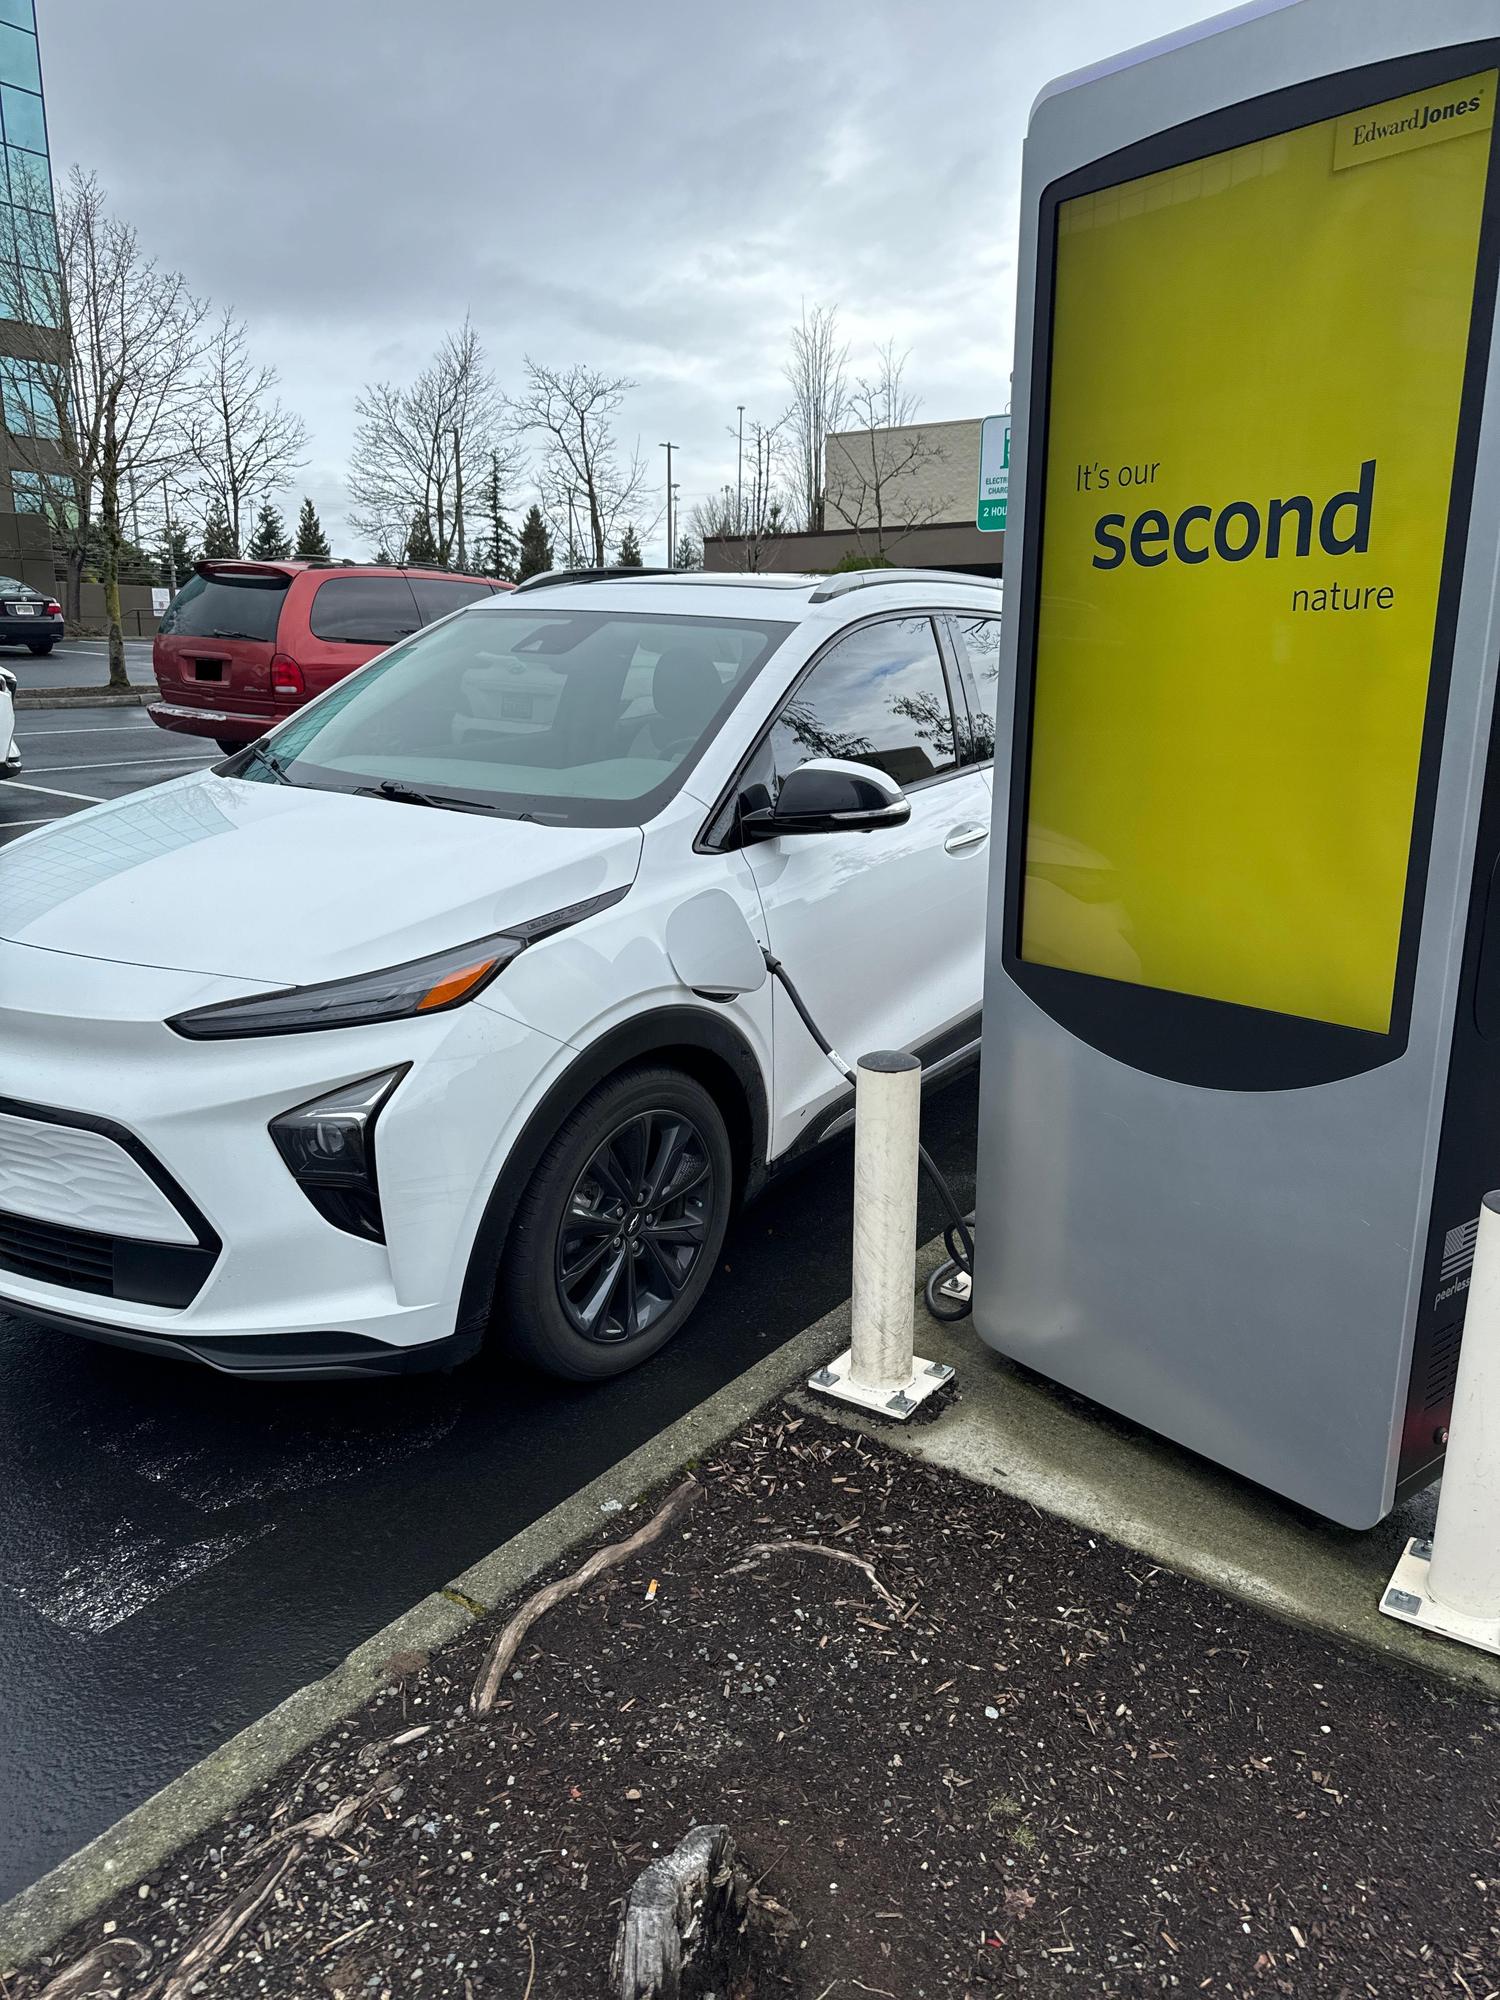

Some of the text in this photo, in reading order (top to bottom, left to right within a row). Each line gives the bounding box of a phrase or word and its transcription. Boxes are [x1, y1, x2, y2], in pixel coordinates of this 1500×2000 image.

[1076, 462, 1160, 492] It's our
[983, 507, 989, 517] 2
[1092, 459, 1377, 570] second
[1292, 582, 1394, 612] nature
[1433, 1276, 1471, 1312] peerless
